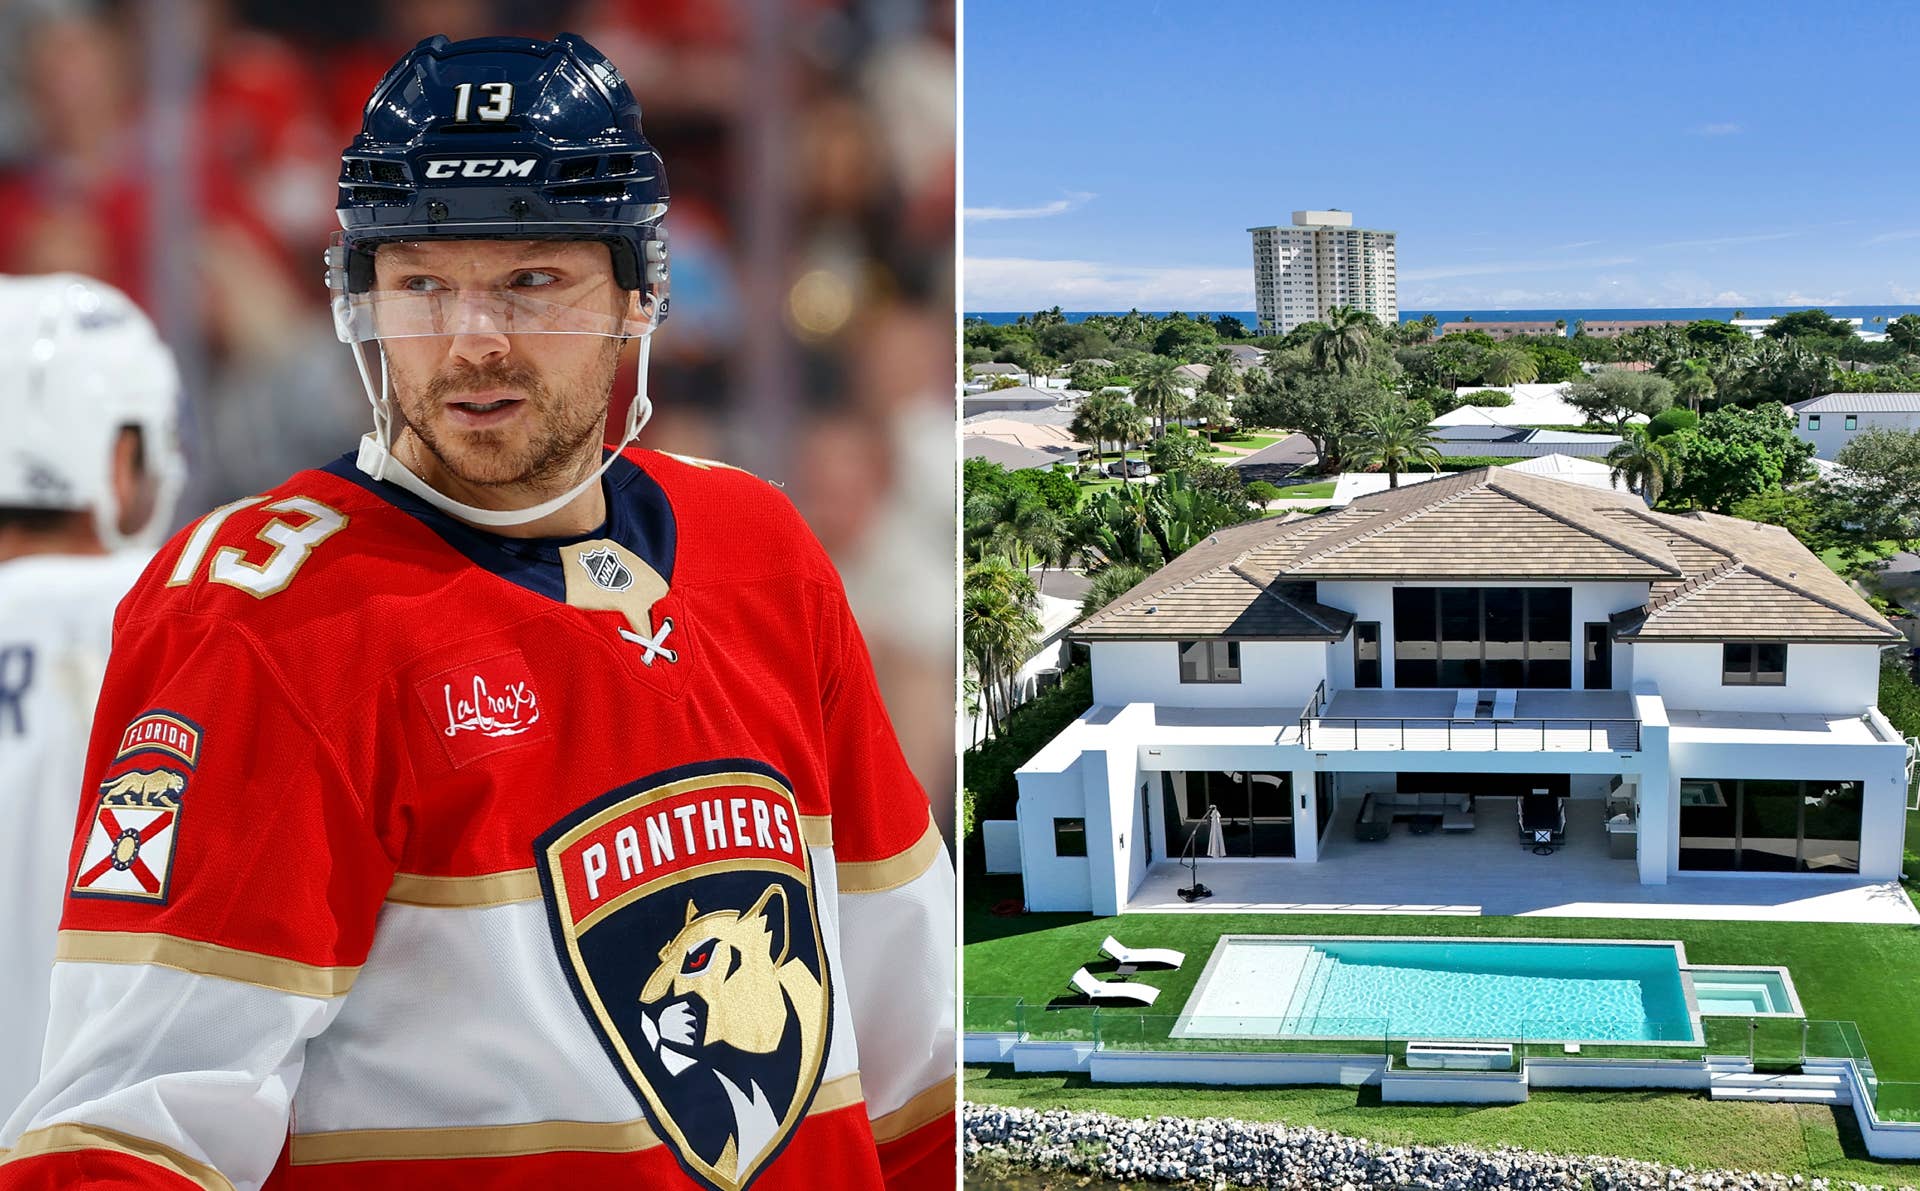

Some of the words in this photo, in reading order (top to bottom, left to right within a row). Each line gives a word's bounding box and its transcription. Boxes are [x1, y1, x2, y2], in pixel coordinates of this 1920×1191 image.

[454, 81, 515, 124] 13
[424, 159, 538, 179] CCM
[166, 494, 350, 600] 13
[599, 558, 617, 586] NHL
[443, 675, 534, 737] LaCroix
[127, 722, 189, 752] FLORIDA
[581, 797, 794, 901] PANTHERS
